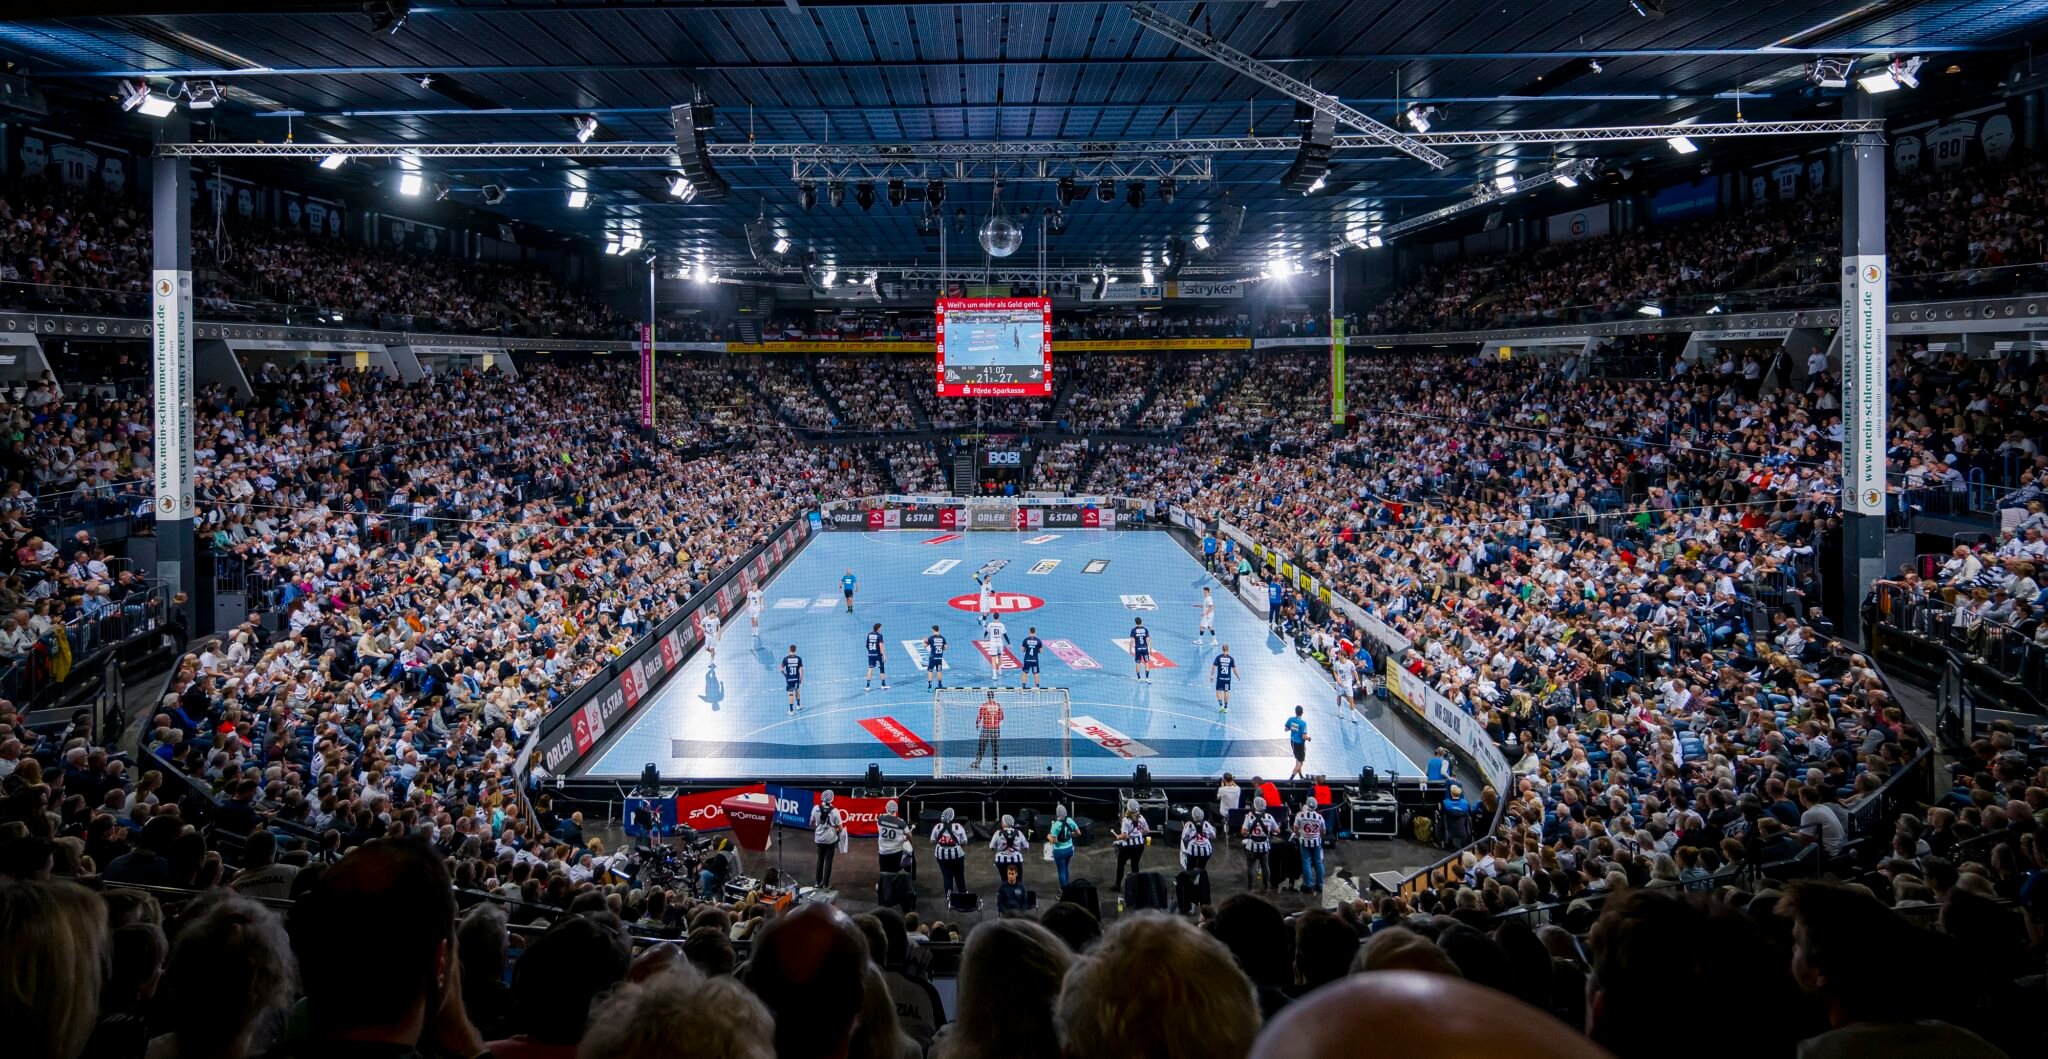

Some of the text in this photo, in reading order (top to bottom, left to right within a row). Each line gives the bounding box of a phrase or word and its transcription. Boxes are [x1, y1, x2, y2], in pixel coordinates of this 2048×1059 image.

[1940, 138, 1960, 159] 80
[69, 160, 83, 179] 10
[1782, 174, 1793, 187] 18
[1184, 283, 1236, 296] stryker
[1024, 302, 1040, 310] geht.
[178, 311, 186, 359] FREUND
[983, 366, 1006, 374] 41:07
[1000, 374, 1012, 383] 27
[992, 388, 1026, 396] Sparkasse
[1862, 291, 1872, 482] www.mein-schlemmerfreund.de
[157, 304, 166, 489] www.mein-schlemmerfreund.de
[988, 451, 1020, 464] BOB!
[835, 514, 863, 522] ORLEN
[1030, 648, 1034, 656] 4
[645, 654, 662, 679] ORLEN
[790, 666, 796, 674] 31
[546, 733, 573, 771] ORLEN
[774, 798, 798, 814] NDR
[730, 812, 766, 820] SPORTCLUB
[882, 828, 896, 840] 20
[1304, 824, 1319, 834] 62
